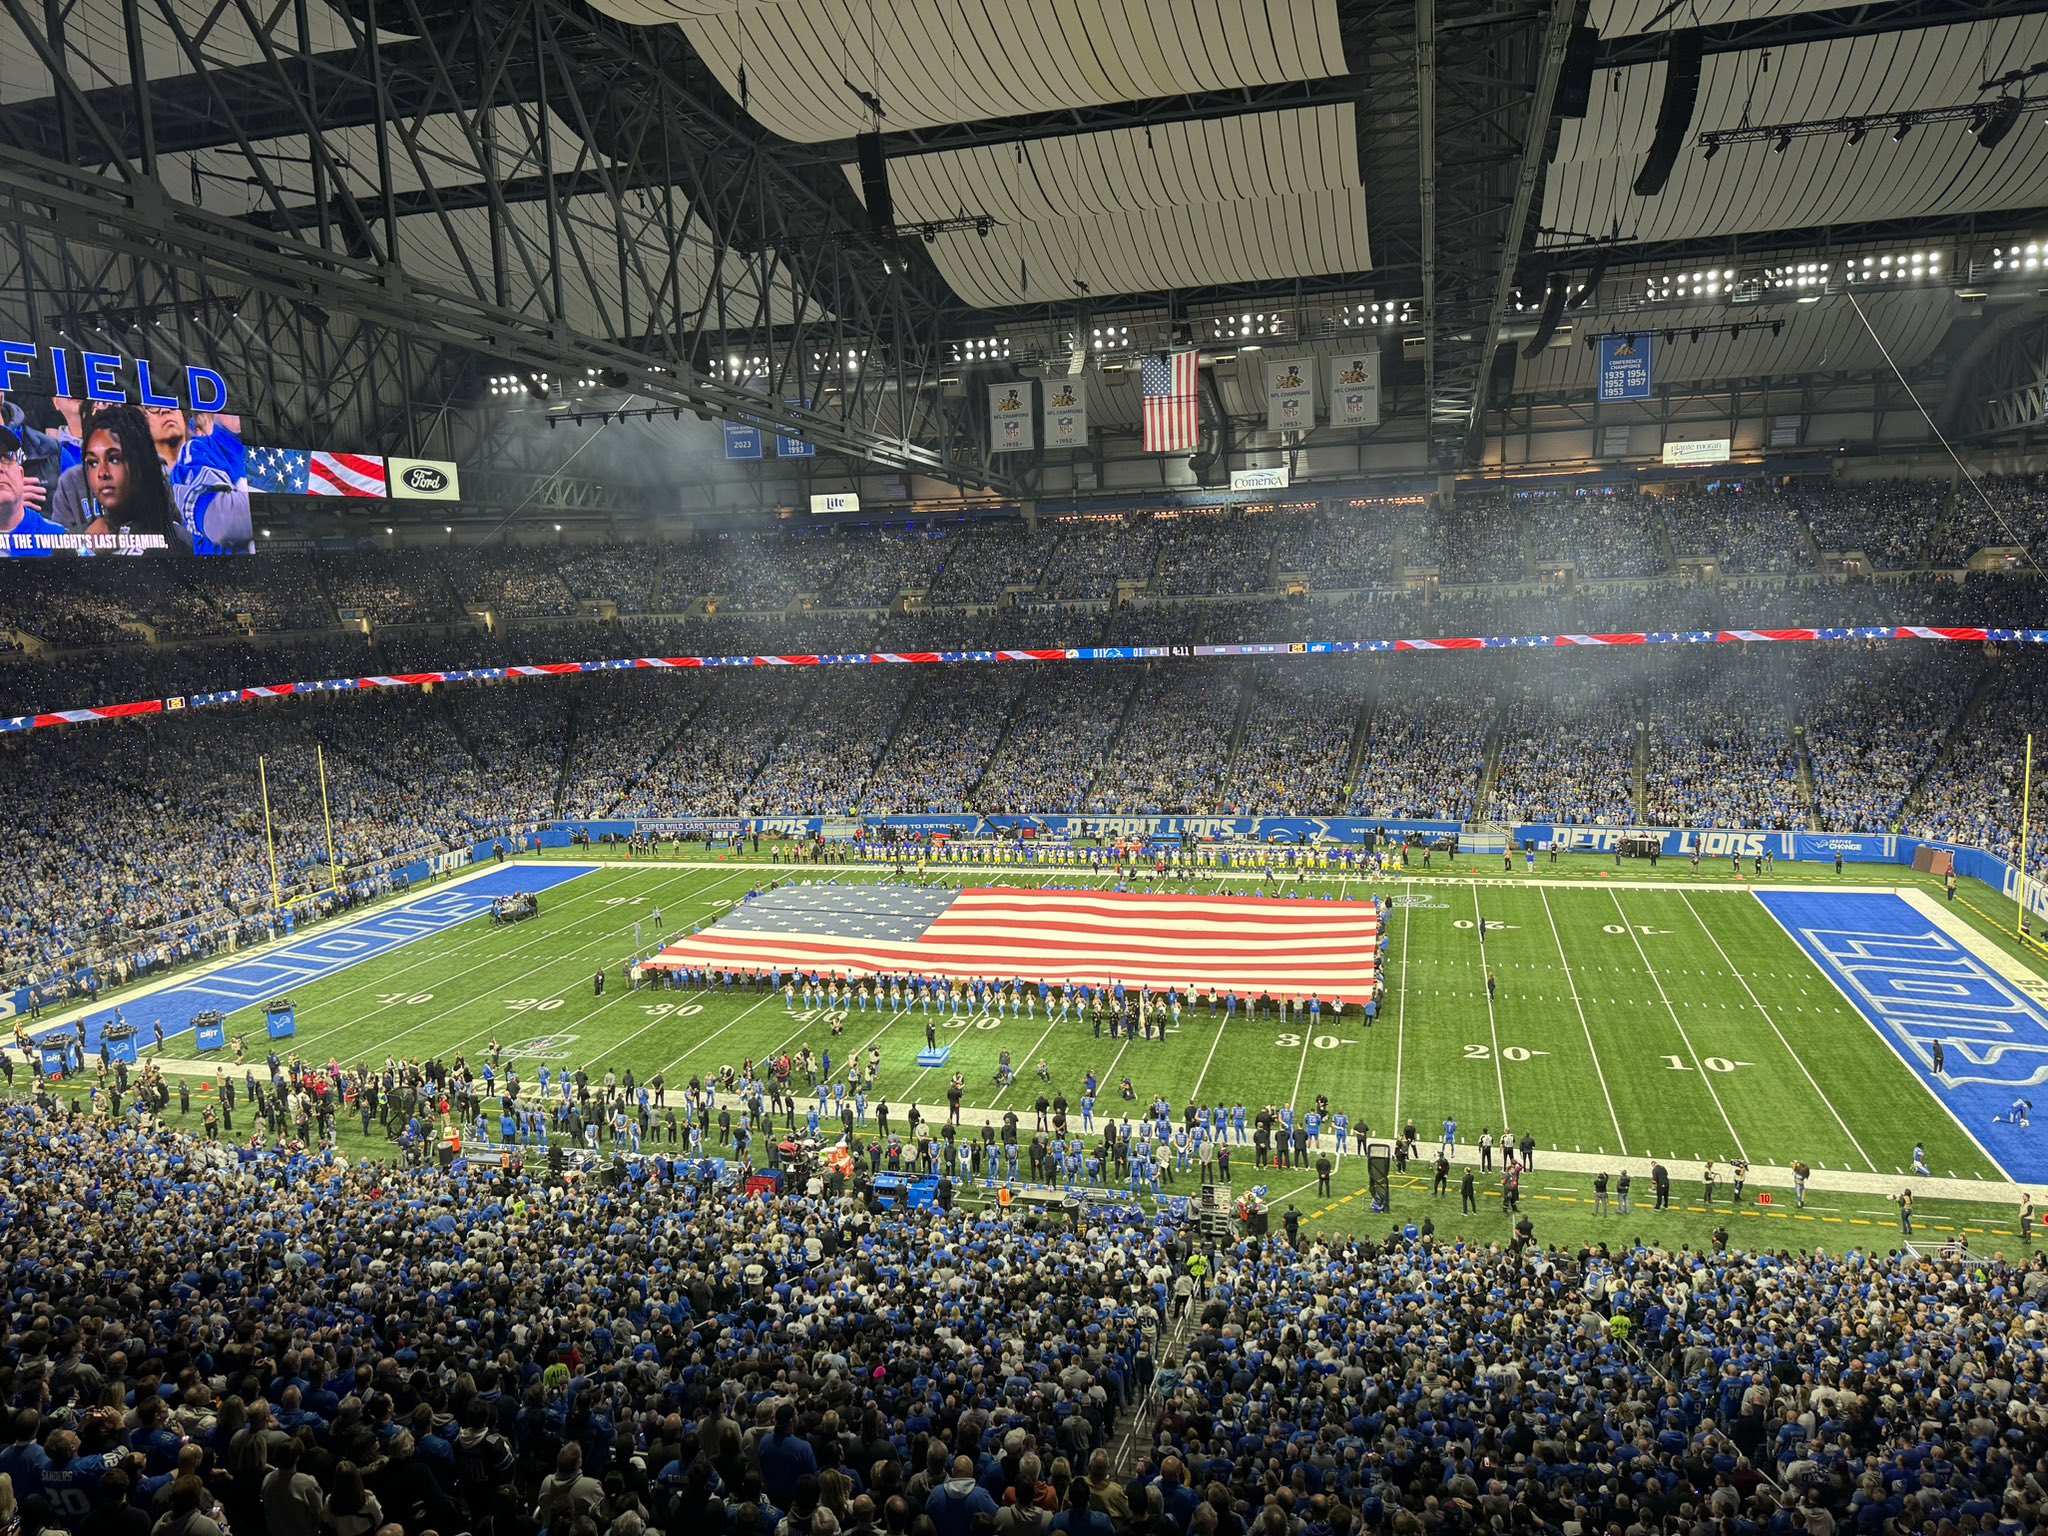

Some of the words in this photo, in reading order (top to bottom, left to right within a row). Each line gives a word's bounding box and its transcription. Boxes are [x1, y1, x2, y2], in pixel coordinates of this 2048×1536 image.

[1609, 358, 1642, 366] CONFERENCE
[1610, 363, 1641, 371] CHAMPIONS
[0, 339, 228, 412] FIELD
[1605, 370, 1625, 380] 1935
[1627, 369, 1647, 378] 1954
[1604, 379, 1624, 388] 1952
[1627, 377, 1647, 387] 1957
[1281, 390, 1310, 398] CHAMPIONS
[1345, 385, 1375, 393] CHAMPIONS
[1604, 388, 1624, 396] 1953
[1057, 408, 1083, 416] CHAMPIONS
[734, 441, 752, 449] 2023
[788, 446, 804, 454] 1993
[1696, 442, 1722, 450] moran
[410, 469, 440, 490] Ford
[825, 496, 845, 510] Lite
[12, 534, 33, 549] THE
[34, 534, 93, 549] TWILIGHT'S
[94, 534, 118, 549] LAST
[119, 534, 169, 550] GLEAMING,
[1172, 646, 1189, 656] 4:11
[641, 823, 666, 831] SUPER
[667, 822, 684, 831] WILD
[684, 822, 705, 830] CARD
[705, 822, 740, 831] WEEKEND
[1165, 819, 1236, 837] LIONS
[1350, 827, 1400, 835] WELCME
[1678, 831, 1766, 855] LIONS
[1829, 843, 1862, 851] CHANGE
[942, 1015, 1001, 1030] 50
[1760, 1194, 1770, 1204] 10
[790, 1253, 803, 1264] 20
[41, 1470, 73, 1482] SANDERS
